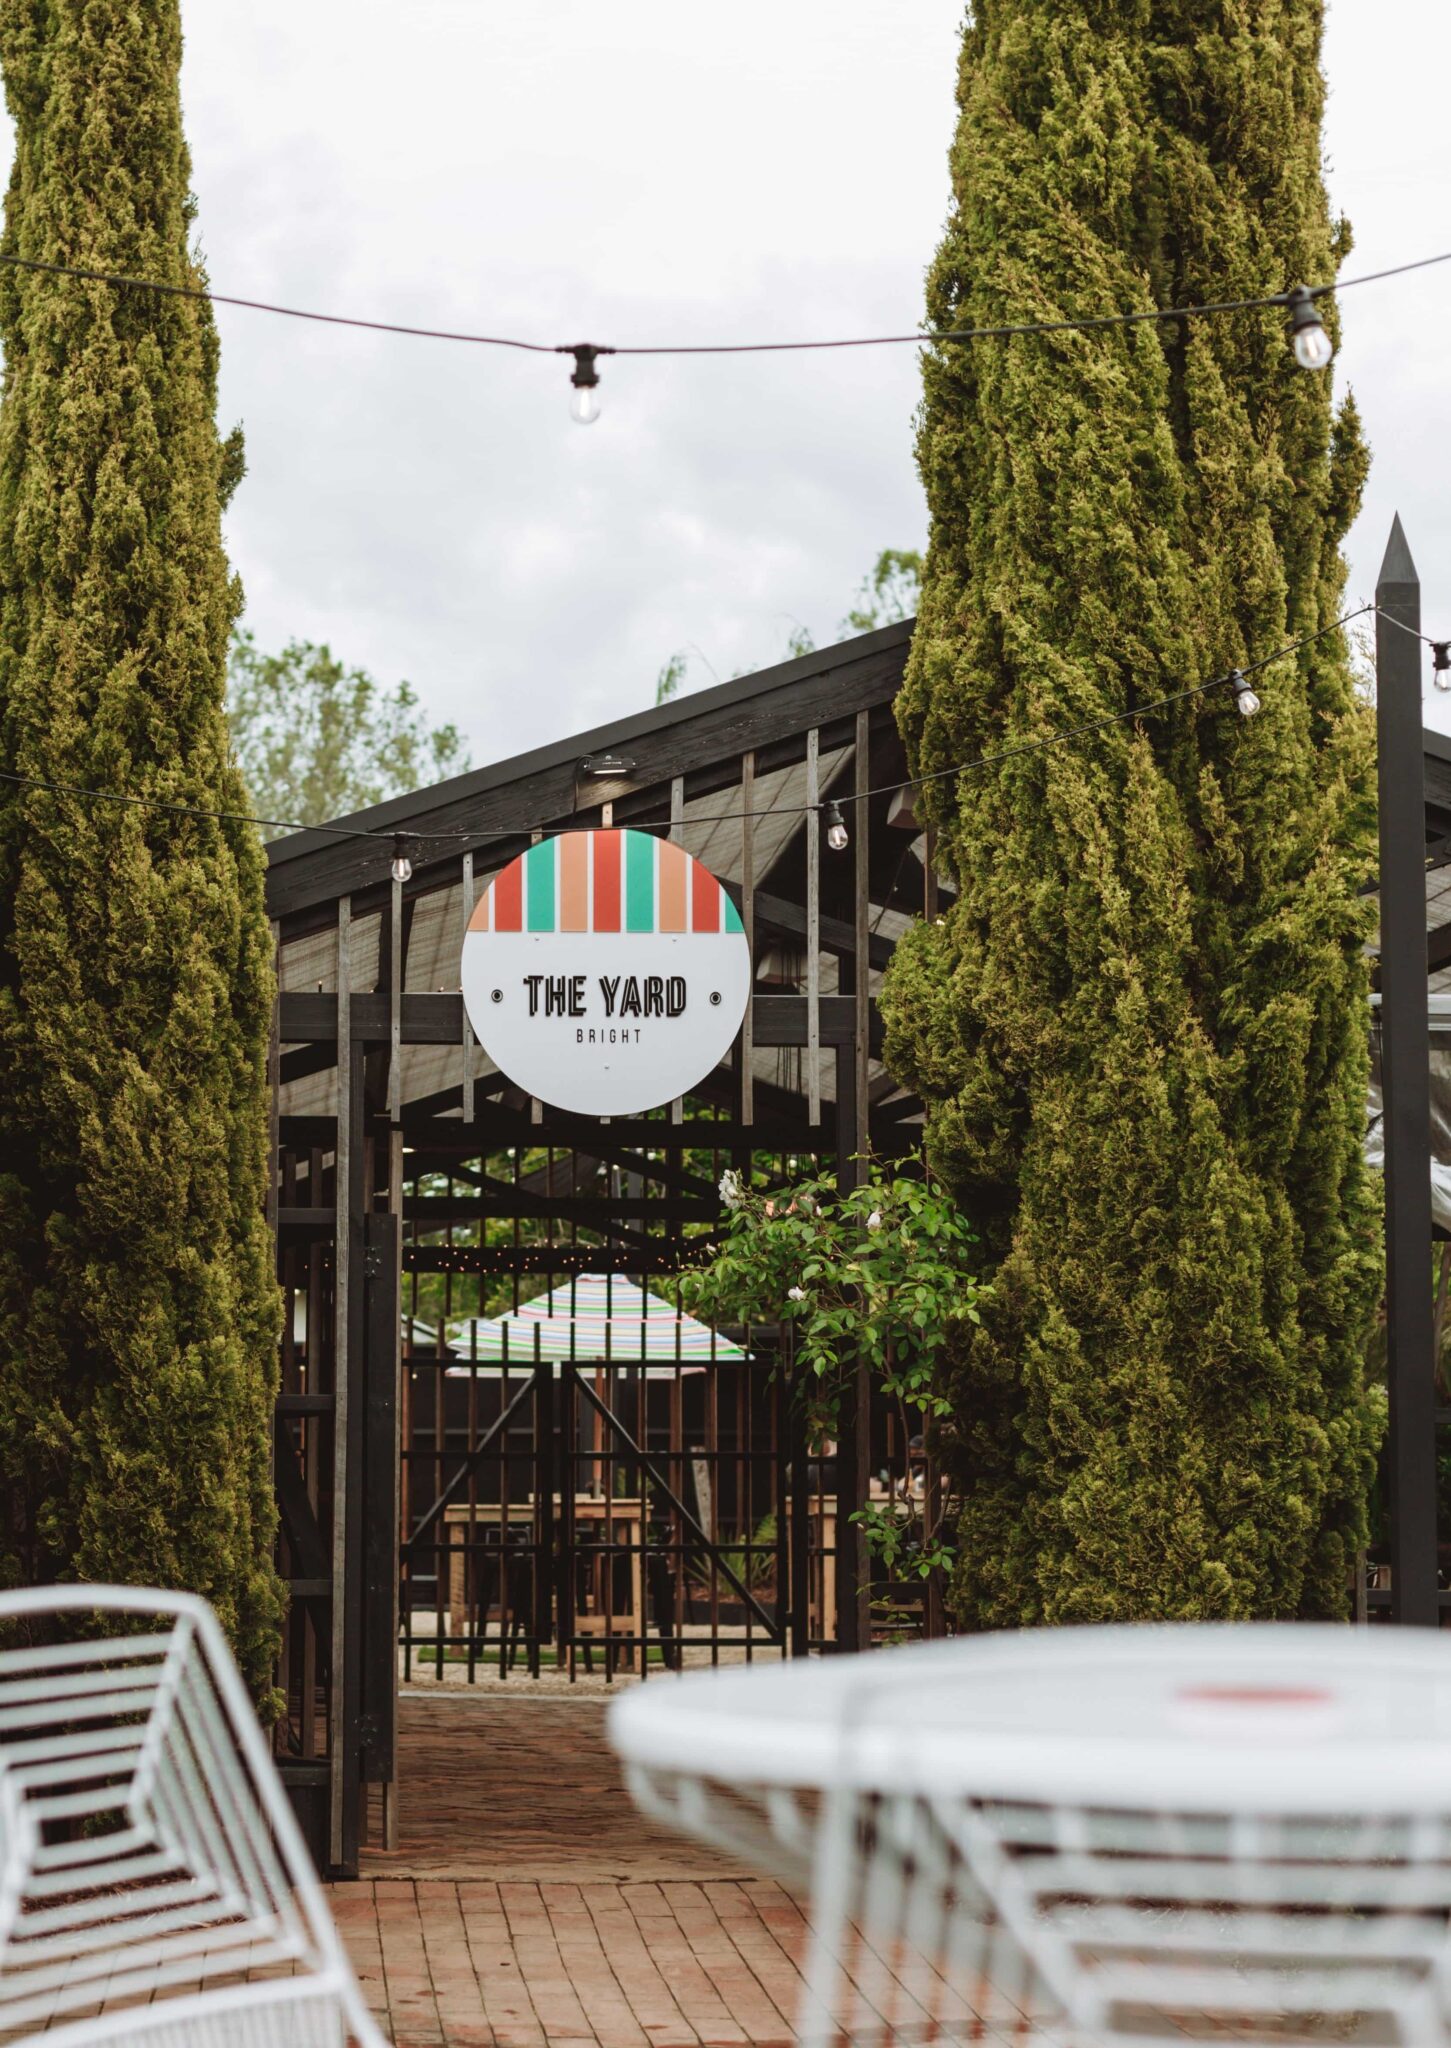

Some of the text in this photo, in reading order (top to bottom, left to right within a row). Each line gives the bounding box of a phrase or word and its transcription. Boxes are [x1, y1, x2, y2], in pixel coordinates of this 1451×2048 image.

[523, 975, 687, 1018] THE YARD
[576, 1028, 641, 1043] BRIGHT
